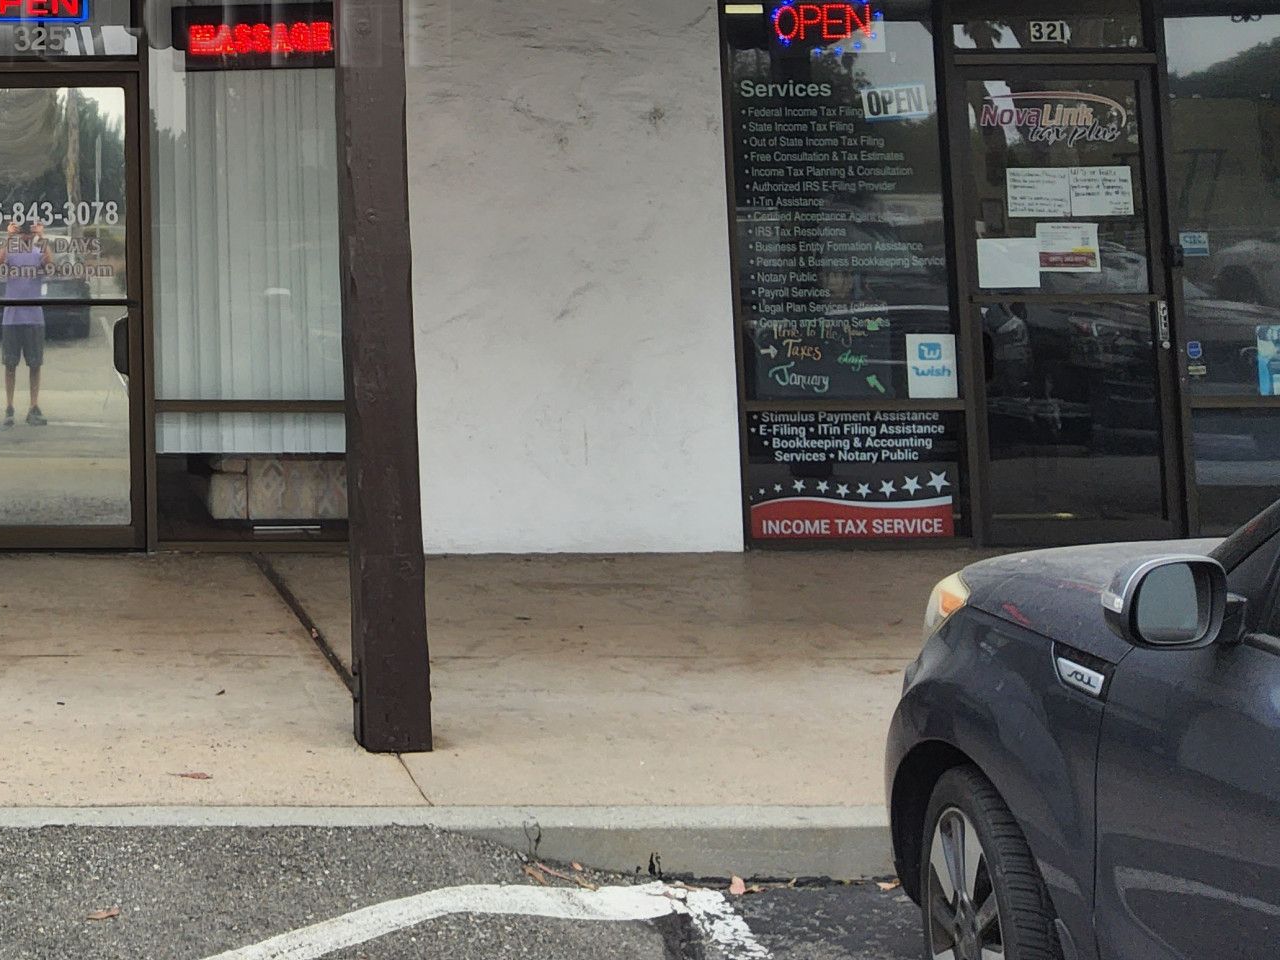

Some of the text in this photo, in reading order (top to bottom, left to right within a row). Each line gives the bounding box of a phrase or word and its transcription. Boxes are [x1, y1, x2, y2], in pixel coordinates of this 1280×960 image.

[773, 3, 872, 40] OPEN
[1032, 22, 1065, 40] 321
[14, 26, 65, 51] 325
[740, 79, 832, 97] Services
[866, 85, 922, 116] OPEN
[748, 106, 863, 118] Federal Income Tax Filing
[749, 121, 854, 133] State Income Tax Filing
[749, 136, 885, 148] Out of State Income Tax Filing
[751, 151, 904, 162] Free Consultation & Tax Estimates
[752, 166, 913, 178] Income Tax Planning & Consultation
[752, 181, 896, 193] Authorized IRS E-Filing Provider
[776, 196, 824, 206] Assistance
[755, 226, 847, 236] IRS Tax Resolutions
[36, 237, 48, 254] 7
[55, 237, 101, 255] DAYS
[756, 241, 923, 253] Business Entity Formation Assistance
[757, 257, 796, 267] Personal
[799, 257, 805, 266] &
[809, 257, 849, 267] Business
[852, 256, 909, 268] Bookkeeping
[757, 272, 817, 283] Notary Public
[758, 287, 831, 298] Payroll Services
[759, 303, 783, 315] Legal
[786, 302, 807, 312] Plan
[809, 302, 847, 313] Services
[783, 338, 822, 361] Taxes
[768, 361, 829, 393] January
[761, 411, 939, 423] Stimulus Payment Assistance
[759, 424, 806, 437] E-Filing
[844, 424, 876, 436] Filing
[879, 422, 945, 434] Assistance
[772, 436, 933, 450] Bookkeeping & Accounting
[775, 449, 919, 464] Services Notary Public
[762, 519, 943, 534] INCOME TAX SERVICE
